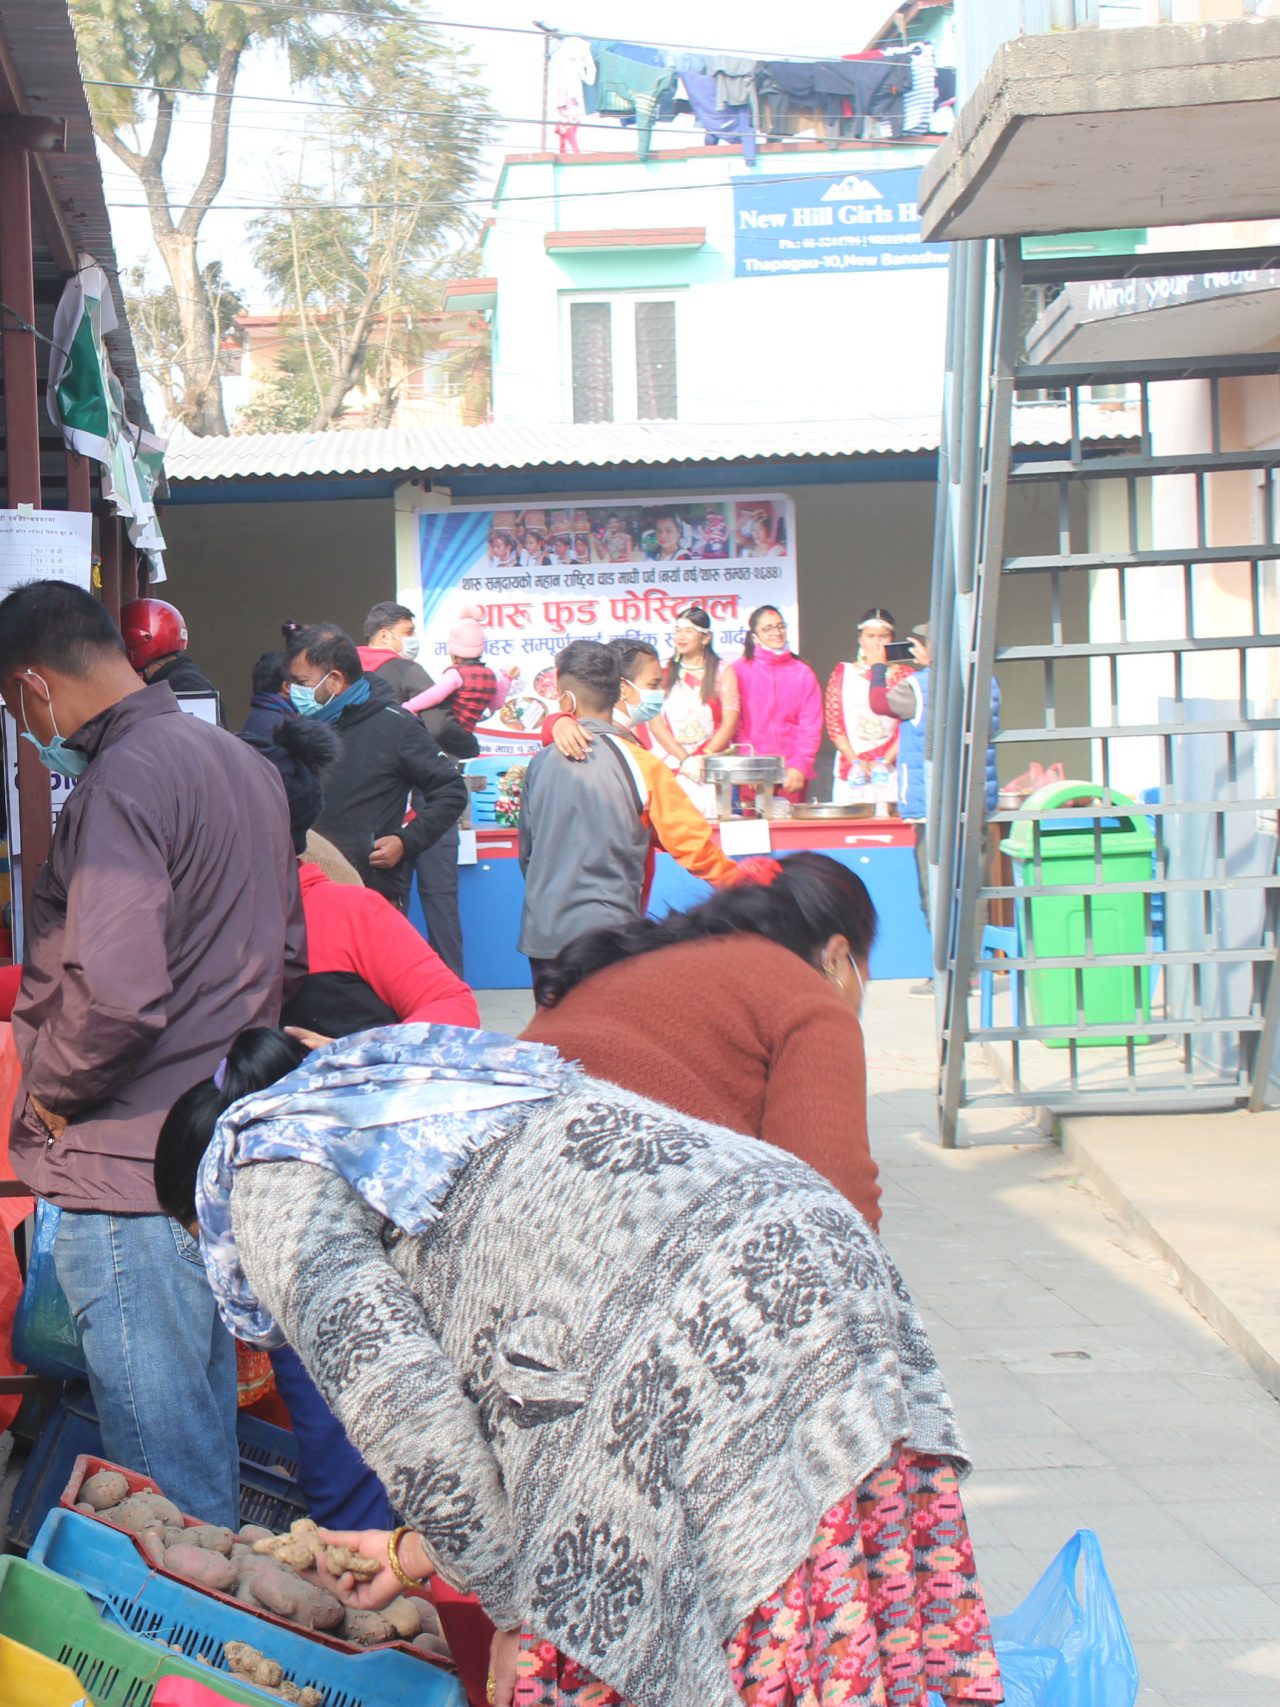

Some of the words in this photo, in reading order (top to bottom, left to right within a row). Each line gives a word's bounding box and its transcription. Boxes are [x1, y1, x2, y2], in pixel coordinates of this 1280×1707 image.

[738, 210, 787, 230] New
[791, 206, 834, 227] Hill
[837, 203, 894, 225] Girls
[1088, 279, 1136, 310] Mind
[1145, 275, 1194, 306] your
[484, 571, 532, 593] समुदायको
[534, 574, 560, 589] महान
[597, 572, 615, 585] चाड
[618, 567, 639, 584] माघी
[542, 600, 600, 634] फुड
[610, 588, 742, 625] फेस्टिवल
